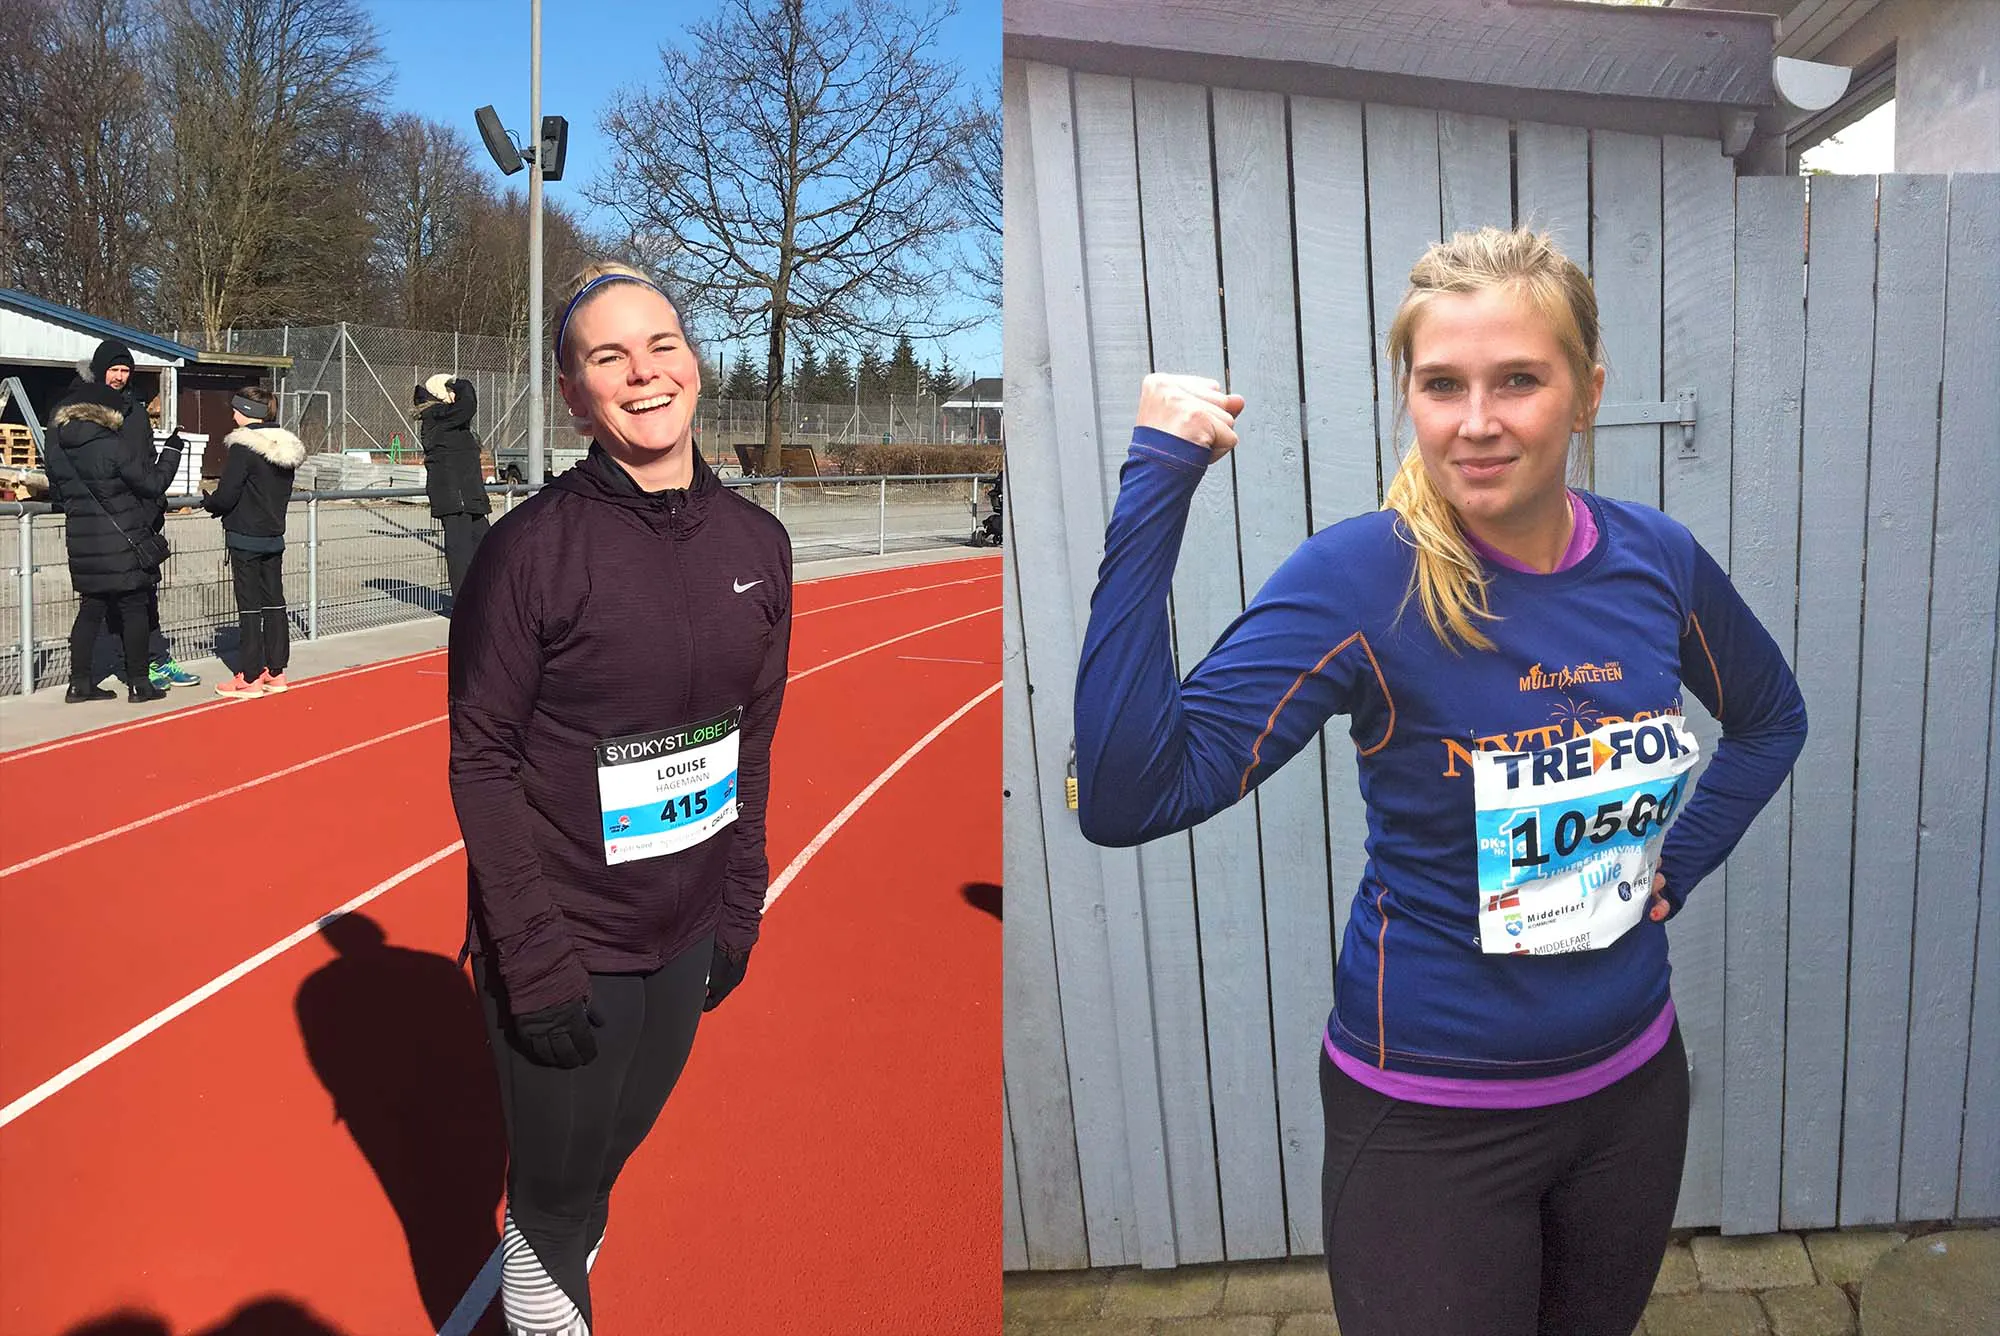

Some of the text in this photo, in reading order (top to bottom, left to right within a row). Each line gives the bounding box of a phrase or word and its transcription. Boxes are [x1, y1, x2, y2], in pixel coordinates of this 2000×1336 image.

[656, 757, 707, 780] LOUISE
[656, 772, 711, 793] HAGEMANN
[660, 790, 709, 823] 415
[1527, 902, 1585, 923] Middelfart
[1534, 931, 1591, 954] MIDDELFART
